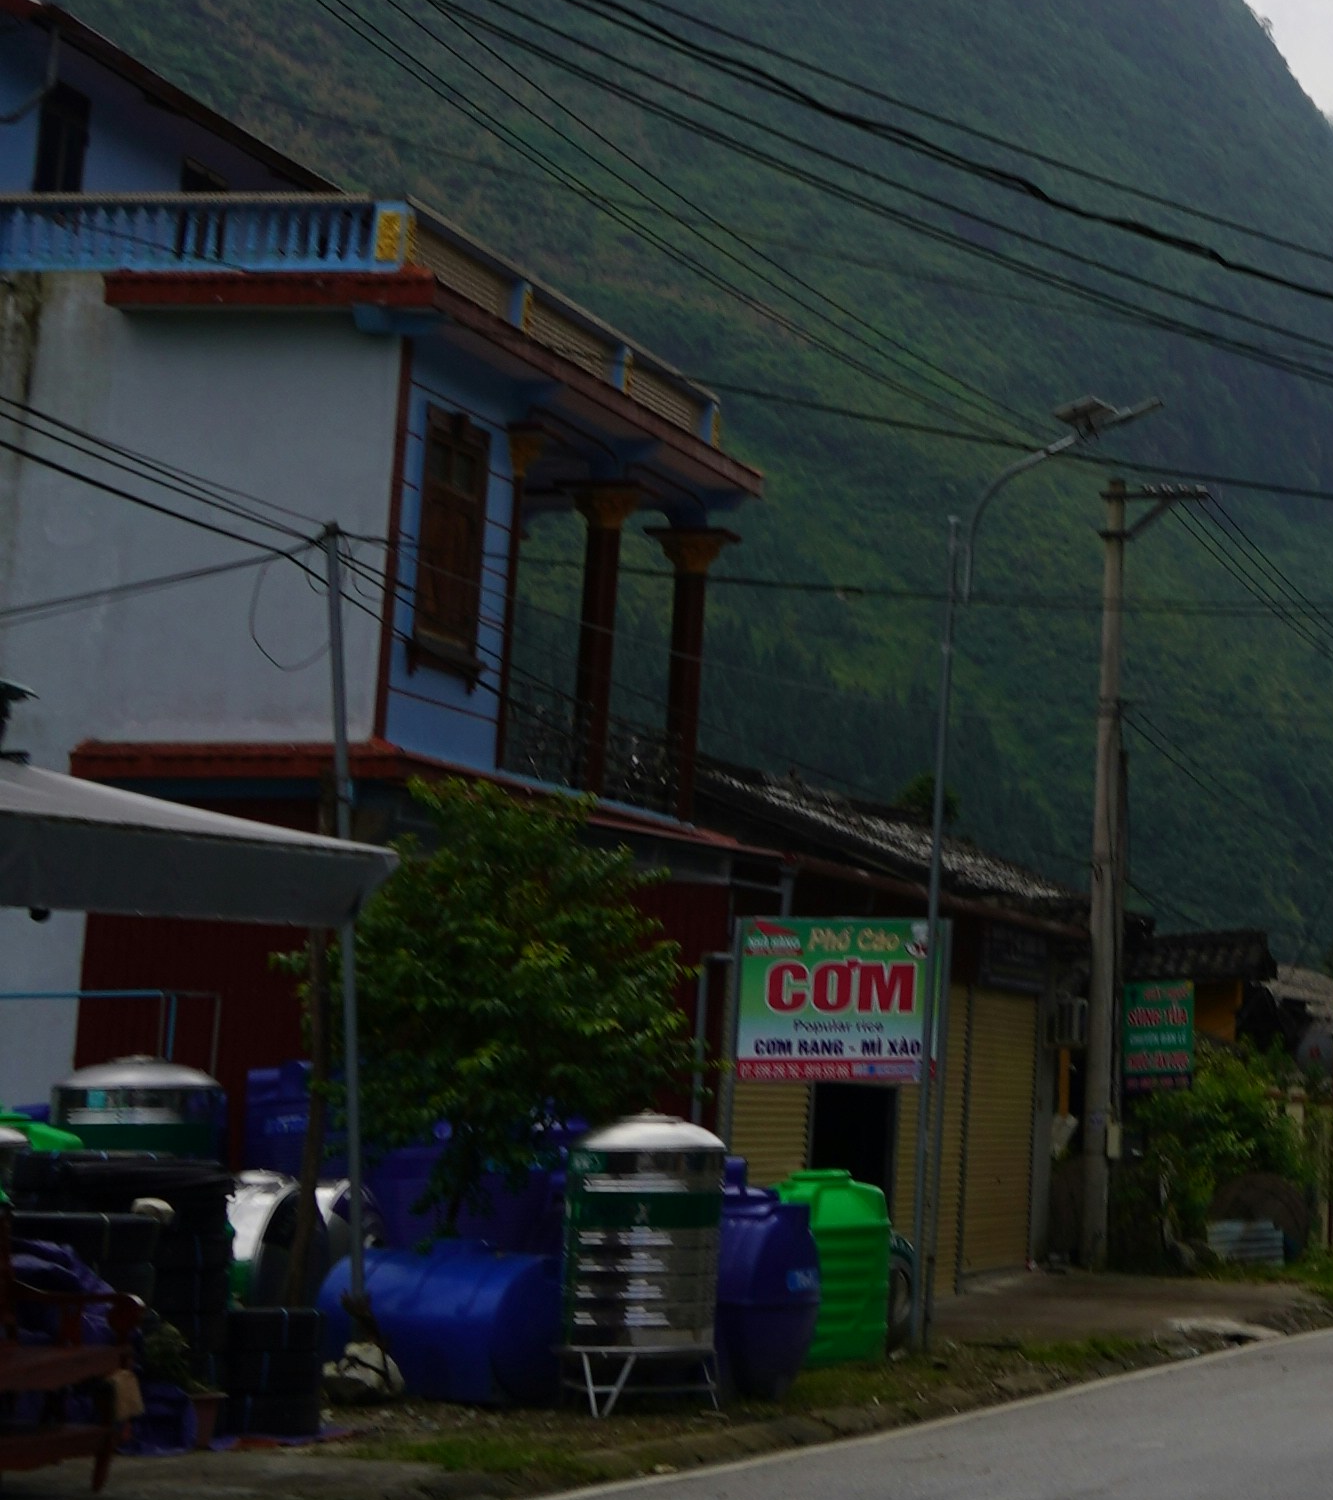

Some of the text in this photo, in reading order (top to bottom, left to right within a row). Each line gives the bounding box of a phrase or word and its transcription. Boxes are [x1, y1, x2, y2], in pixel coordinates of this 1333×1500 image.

[766, 957, 916, 1013] CƠM
[793, 1018, 851, 1034] Popular
[754, 1037, 793, 1056] CƠM
[798, 1038, 844, 1056] RANG
[888, 1035, 921, 1056] XÀO
